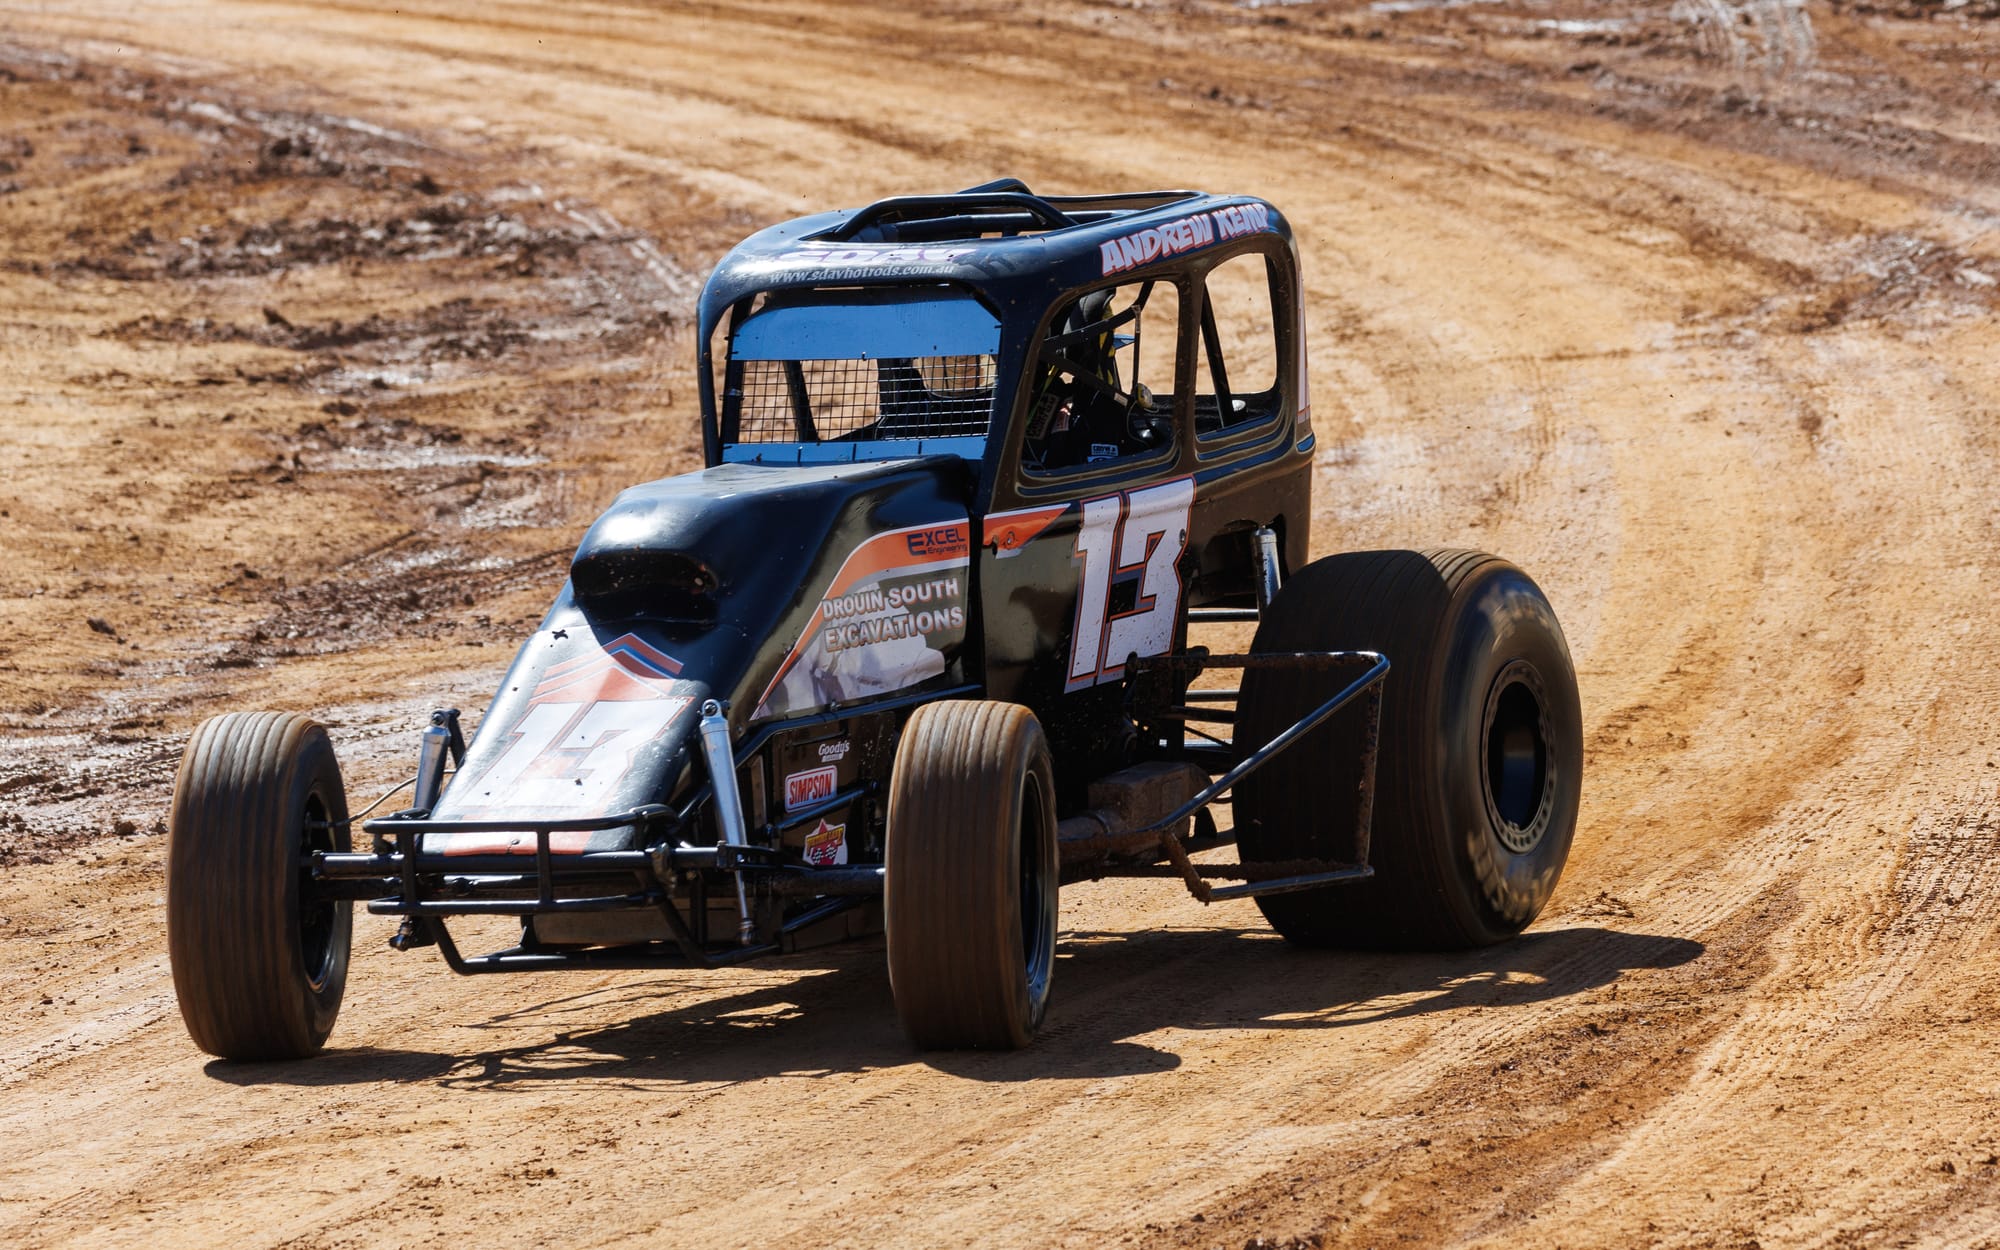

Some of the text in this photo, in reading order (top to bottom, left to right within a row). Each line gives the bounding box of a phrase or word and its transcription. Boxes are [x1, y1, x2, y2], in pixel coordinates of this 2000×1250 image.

[1100, 202, 1269, 277] ANDREW KEMP
[769, 264, 955, 284] www.sdavhotrods.com.au
[906, 527, 966, 556] EXCEL
[927, 543, 968, 556] Engineering
[822, 577, 960, 622] DROUIN SOUTH
[1066, 474, 1197, 692] 13
[824, 605, 965, 653] EXCAVATIONS
[457, 697, 695, 808] 13
[818, 740, 850, 761] Goody's
[788, 773, 833, 806] SIMPSON
